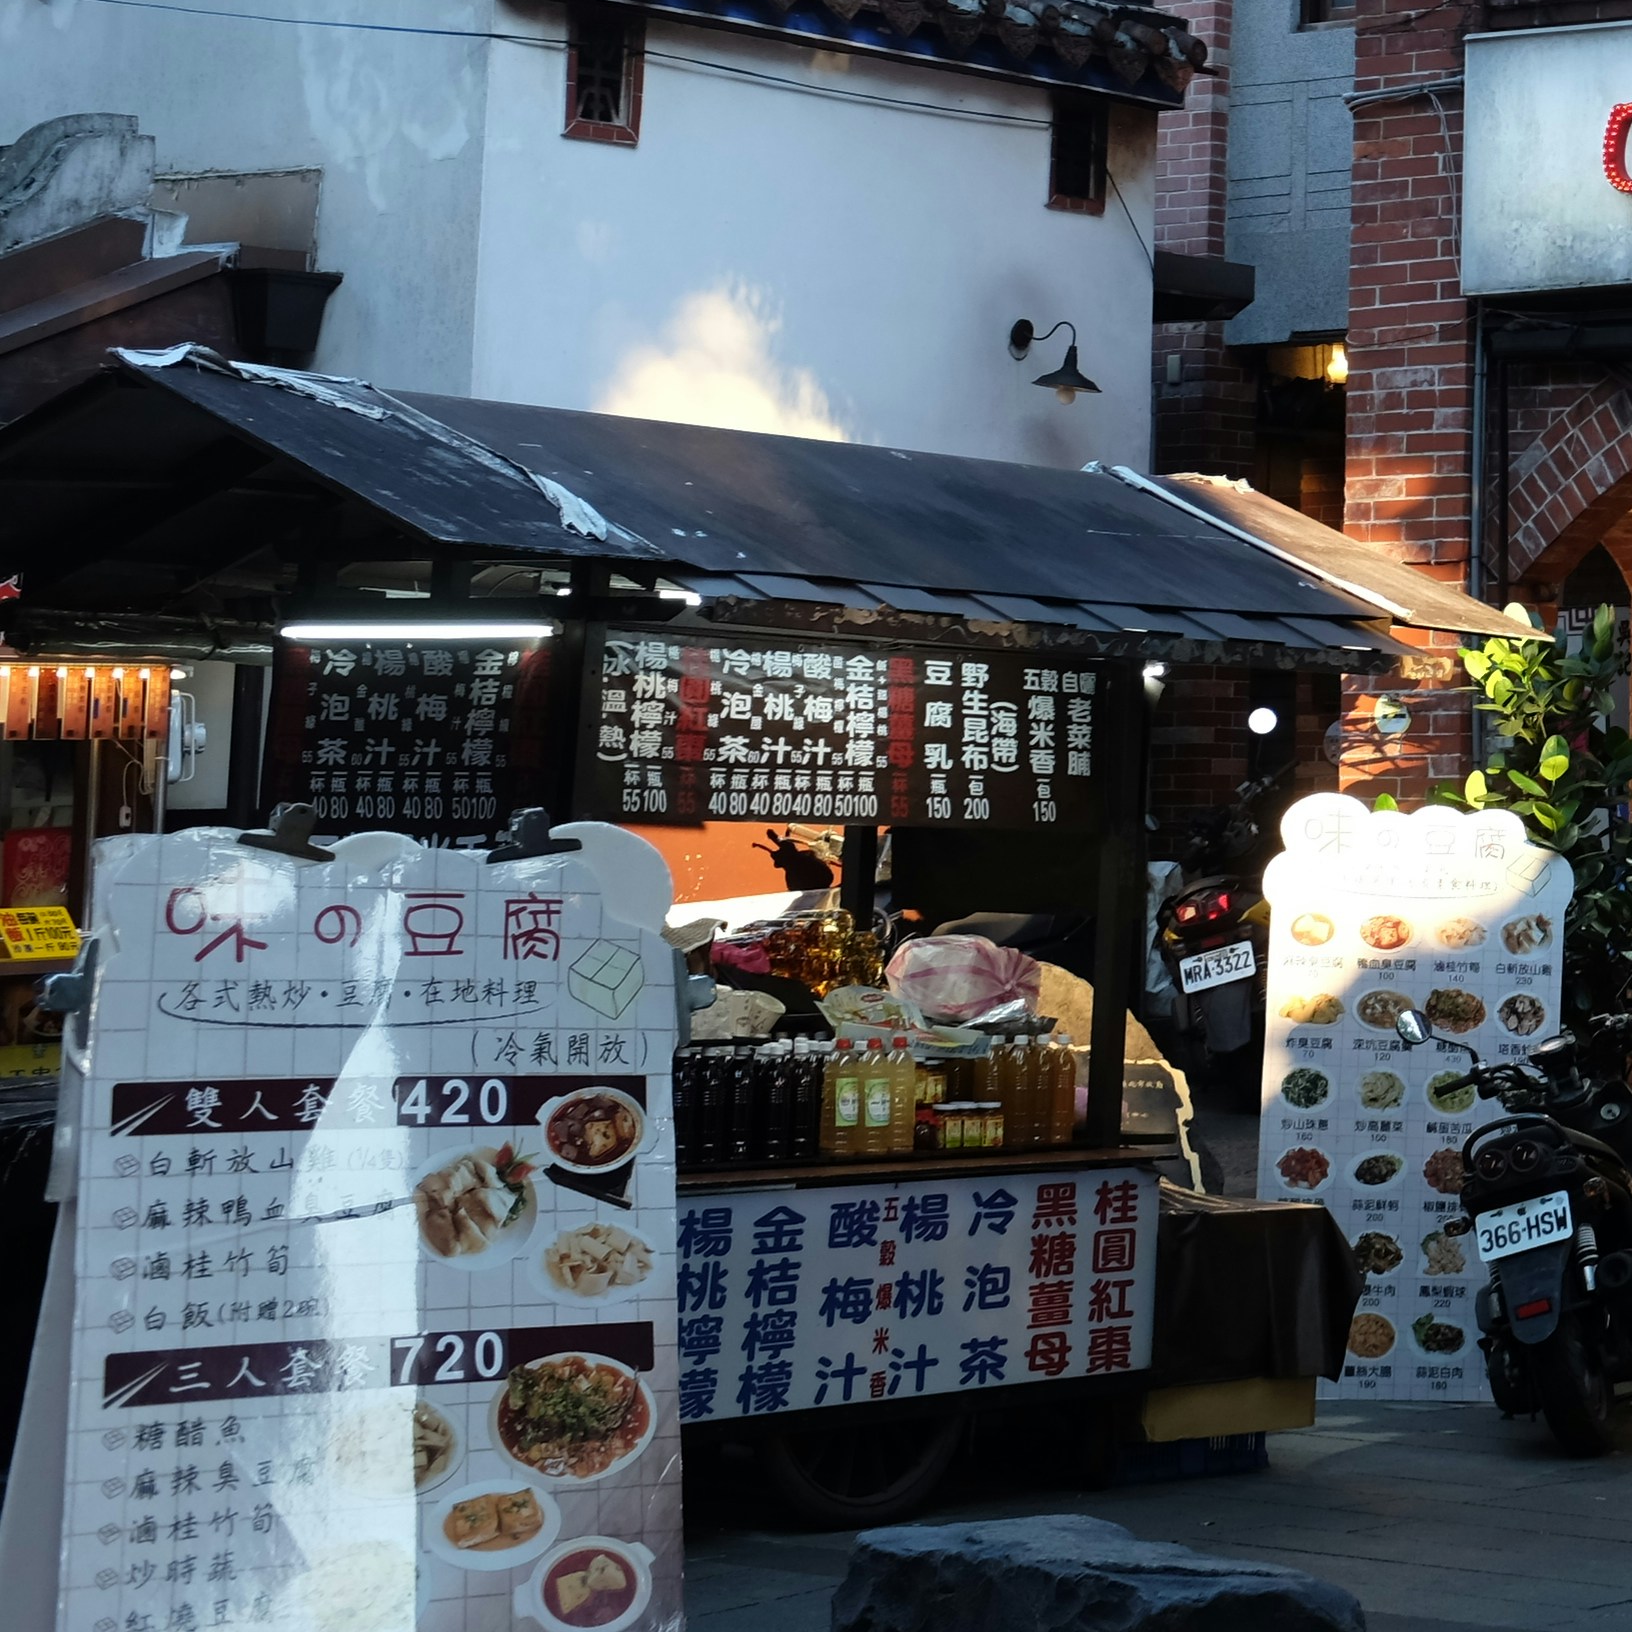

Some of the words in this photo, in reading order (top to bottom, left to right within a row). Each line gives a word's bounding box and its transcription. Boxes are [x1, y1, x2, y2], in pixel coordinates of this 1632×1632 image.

[316, 648, 357, 767] 冷泡茶
[364, 648, 405, 767] 楊桃汁
[412, 649, 453, 767] 酸梅汁
[461, 648, 505, 767] 金桔檸檬
[629, 642, 667, 759] 楊桃檸檬
[718, 649, 751, 763] 冷泡茶
[761, 650, 793, 764] 楊桃汁
[801, 653, 833, 765] 酸梅汁
[846, 654, 876, 767] 金桔檸檬
[923, 659, 954, 769] 豆腐乳
[961, 662, 990, 772] 野生昆布
[989, 700, 1020, 773] (海帶)
[330, 796, 349, 819] 80
[355, 796, 375, 819] 40
[376, 796, 396, 819] 80
[402, 796, 421, 819] 40
[424, 796, 444, 819] 80
[452, 796, 471, 820] 50
[471, 796, 497, 820] 100
[622, 788, 641, 813] 55
[643, 789, 668, 813] 100
[709, 792, 727, 815] 40
[729, 792, 748, 815] 80
[750, 792, 771, 815] 40
[772, 792, 792, 816] 80
[792, 792, 812, 816] 40
[813, 793, 833, 816] 80
[834, 793, 853, 816] 50
[853, 794, 878, 817] 100
[926, 796, 951, 819] 150
[963, 797, 990, 820] 200
[1033, 800, 1057, 822] 150
[1378, 972, 1395, 981] 100
[1515, 976, 1533, 986] 230
[472, 1031, 649, 1068] (冷氣開放)
[1302, 1050, 1315, 1059] 70
[1374, 1051, 1391, 1061] 120
[184, 1084, 386, 1129] 雙人套餐
[400, 1079, 509, 1125] 420
[1480, 1206, 1568, 1253] 366-HSW
[142, 1245, 290, 1282] 滷桂竹筍
[1024, 1183, 1077, 1378] 黑糖薑母
[1086, 1180, 1137, 1373] 桂圓紅棗
[813, 1200, 880, 1407] 酸梅汁
[868, 1196, 900, 1400] 五穀爆米香
[887, 1194, 950, 1396] 楊桃汁
[958, 1188, 1019, 1386] 冷泡茶
[1362, 1298, 1380, 1307] 200
[1434, 1299, 1451, 1308] 220
[736, 1204, 806, 1415] 金桔檸檬
[168, 1344, 375, 1397] 三人套餐
[394, 1331, 504, 1382] 720
[131, 1414, 247, 1453] 糖醋魚
[129, 1458, 317, 1500] 麻辣臭豆腐
[129, 1503, 275, 1545] 滷桂竹筍
[125, 1550, 238, 1590] 炒時蔬
